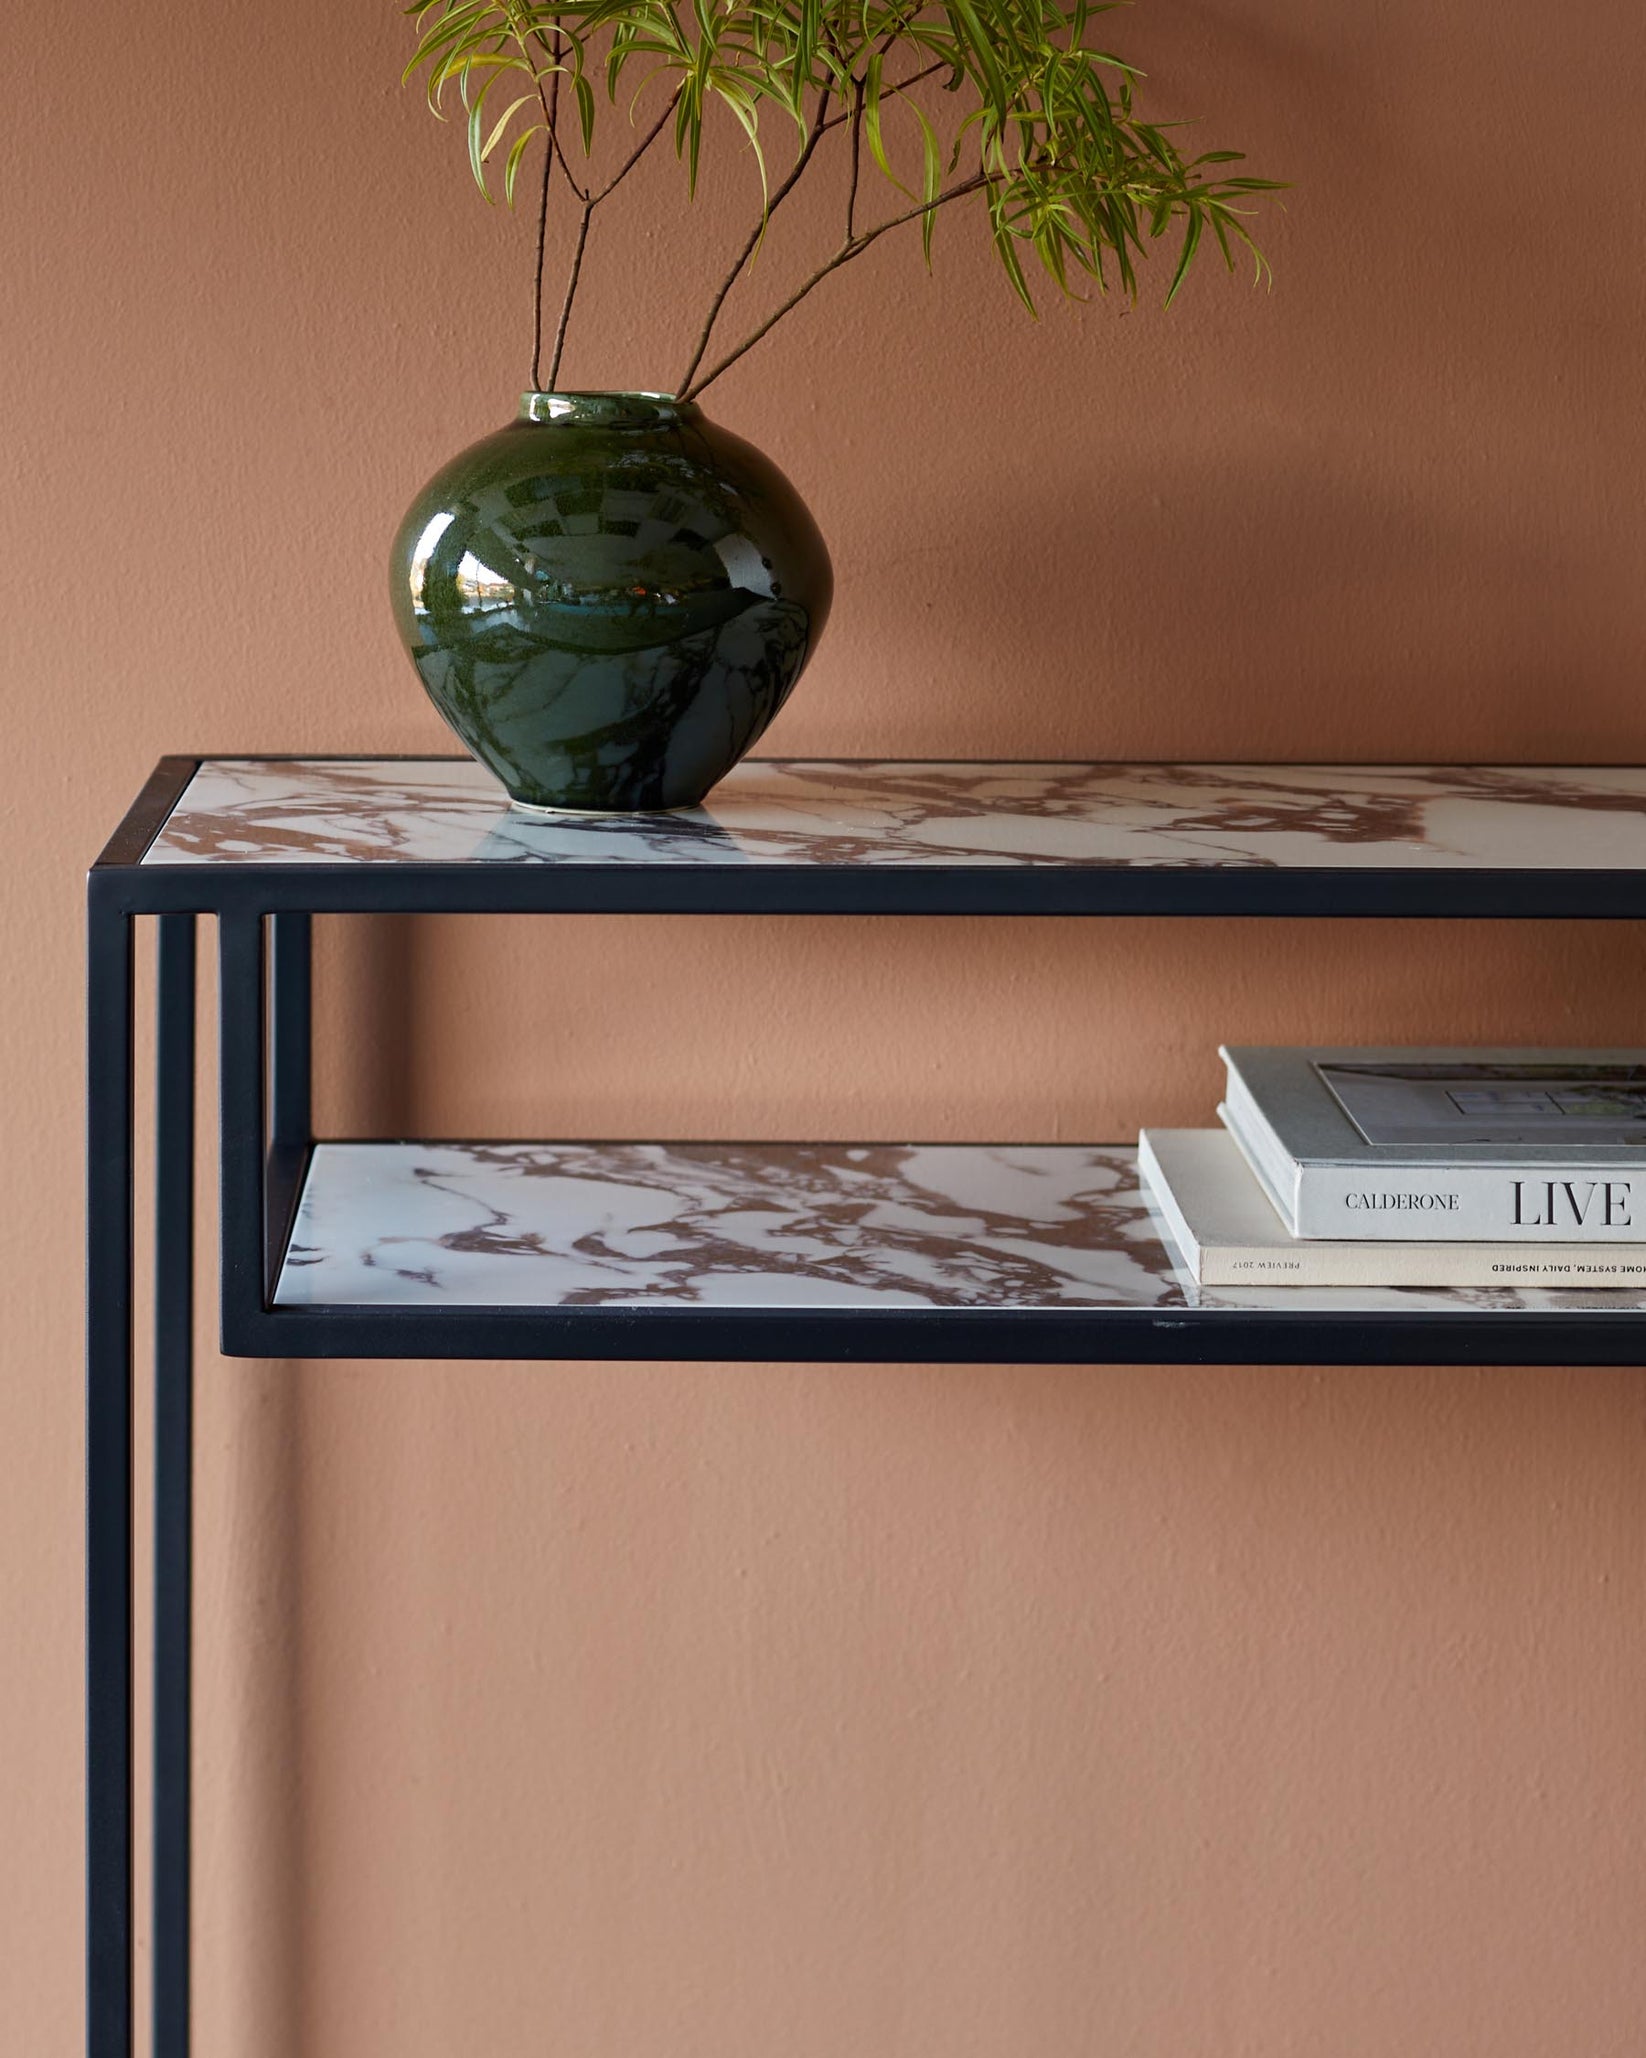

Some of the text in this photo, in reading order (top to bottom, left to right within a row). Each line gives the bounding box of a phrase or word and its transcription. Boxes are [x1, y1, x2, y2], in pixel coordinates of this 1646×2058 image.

[1345, 1181, 1632, 1226] CALDERONE LIVE
[1232, 1261, 1300, 1270] PREVIEW 2017
[1491, 1264, 1540, 1273] INSPIRED
[1542, 1264, 1571, 1273] DAILY
[1573, 1264, 1618, 1273] SYSTEM,
